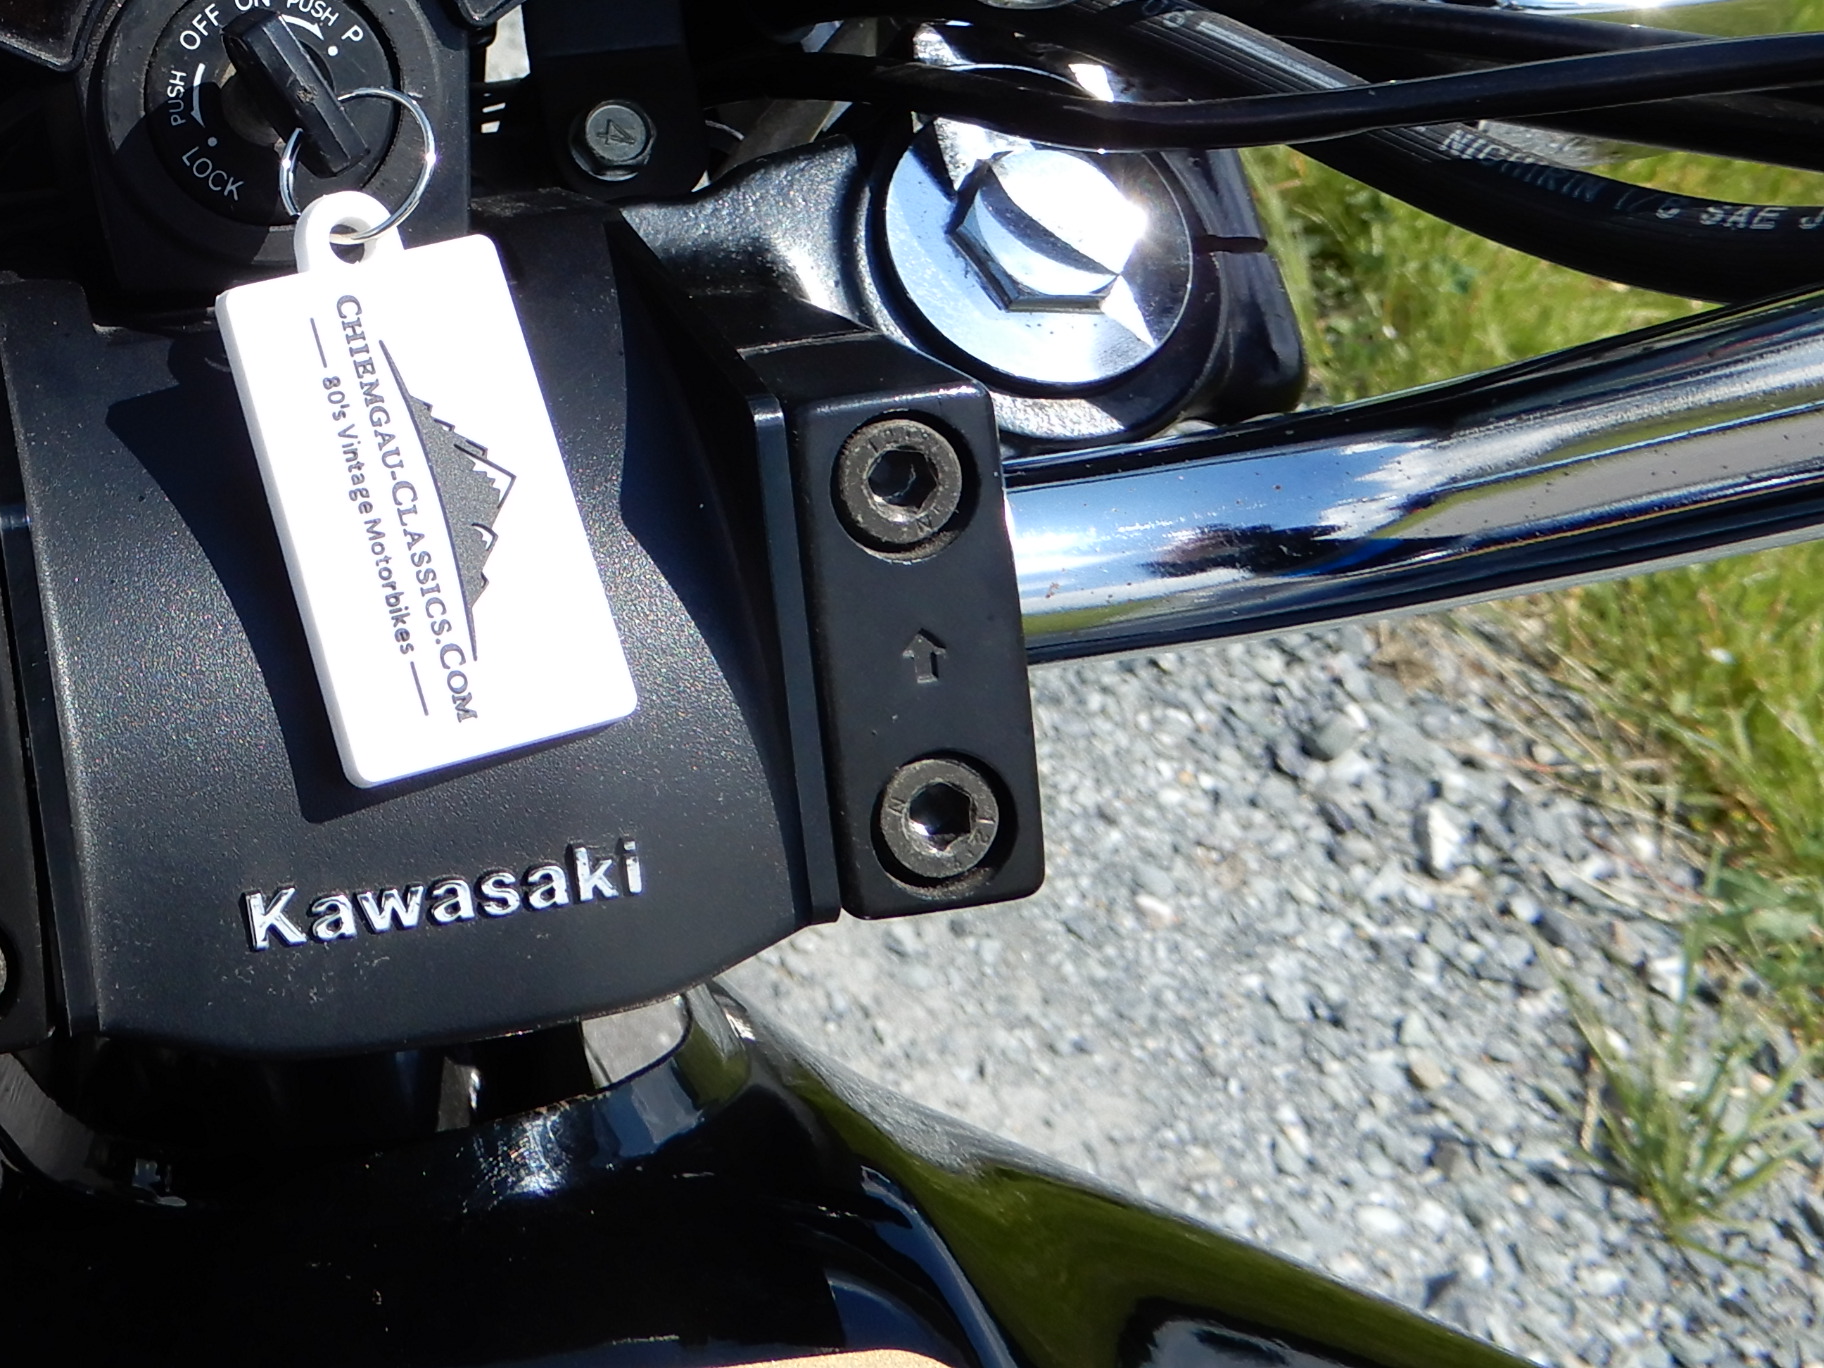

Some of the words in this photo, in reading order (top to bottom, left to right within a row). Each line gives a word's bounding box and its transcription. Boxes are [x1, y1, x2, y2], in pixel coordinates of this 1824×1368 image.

[179, 5, 222, 51] OFF
[341, 26, 363, 50] P
[167, 70, 187, 126] PUSH
[181, 145, 243, 201] LOCK
[322, 374, 348, 419] 80's
[337, 422, 375, 517] Vintage
[366, 518, 417, 655] Motorbikes
[242, 838, 644, 951] Kawasaki
